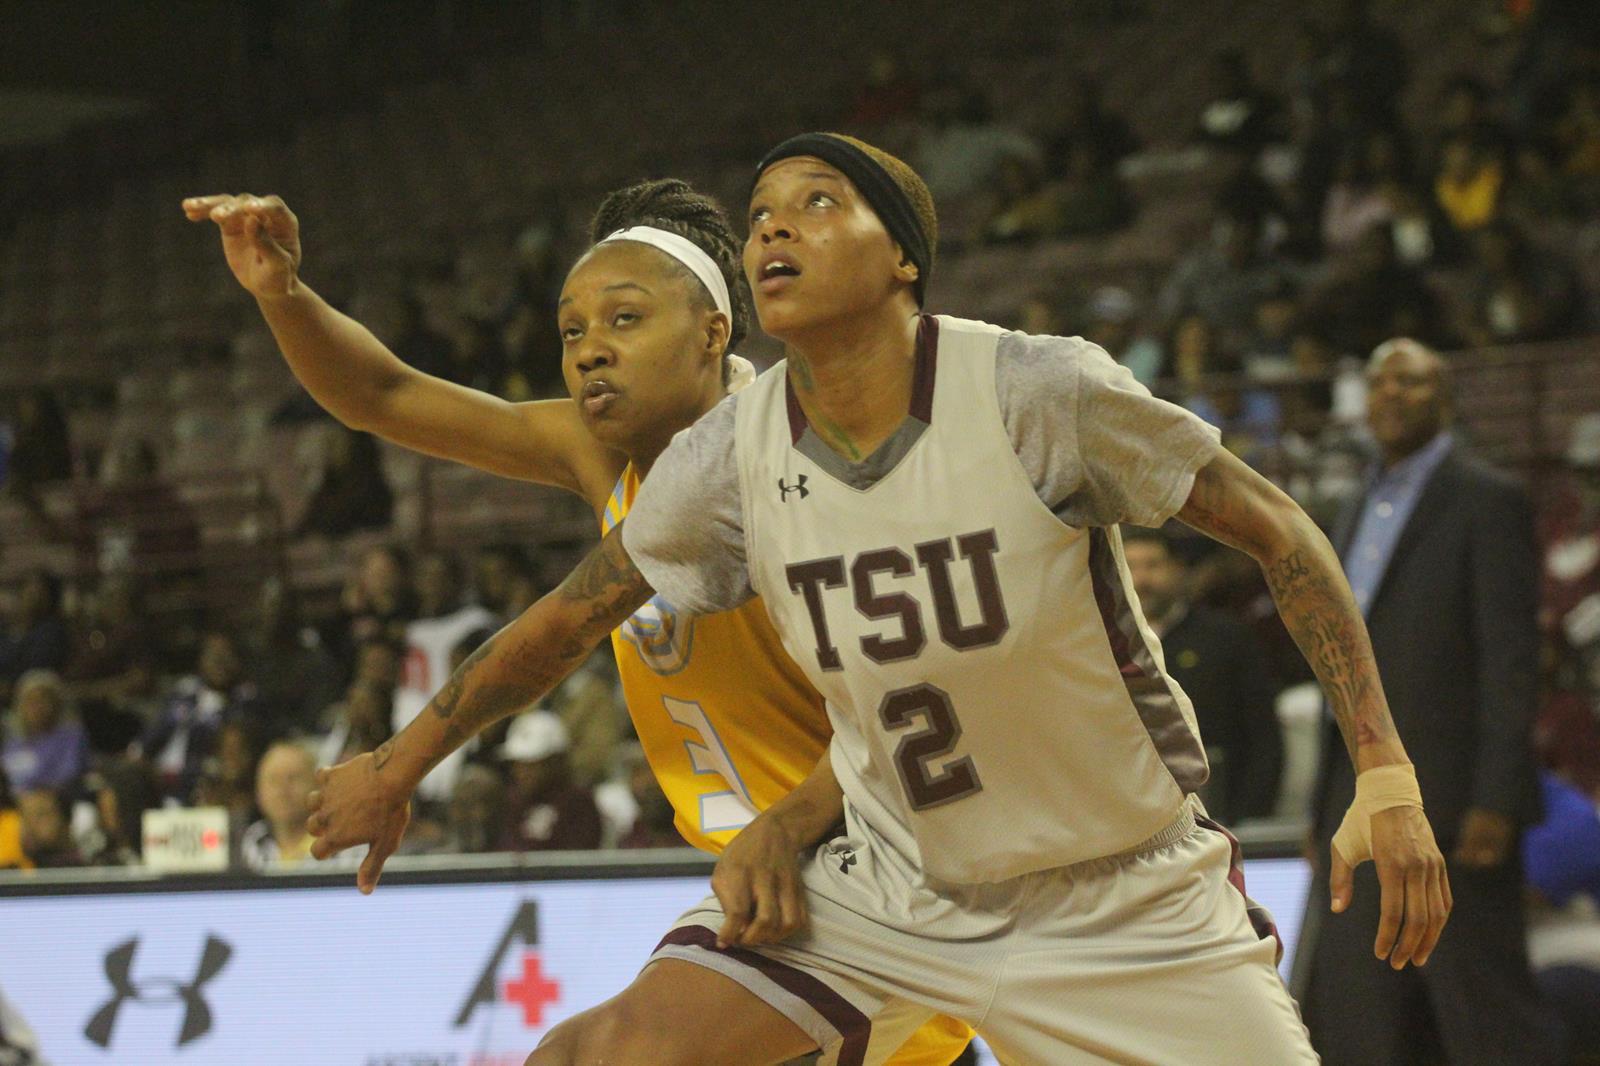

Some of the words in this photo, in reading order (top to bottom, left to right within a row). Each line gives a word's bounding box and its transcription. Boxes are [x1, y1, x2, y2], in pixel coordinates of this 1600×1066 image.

[785, 527, 1010, 672] TSU
[661, 694, 762, 834] 3
[878, 682, 984, 812] 2
